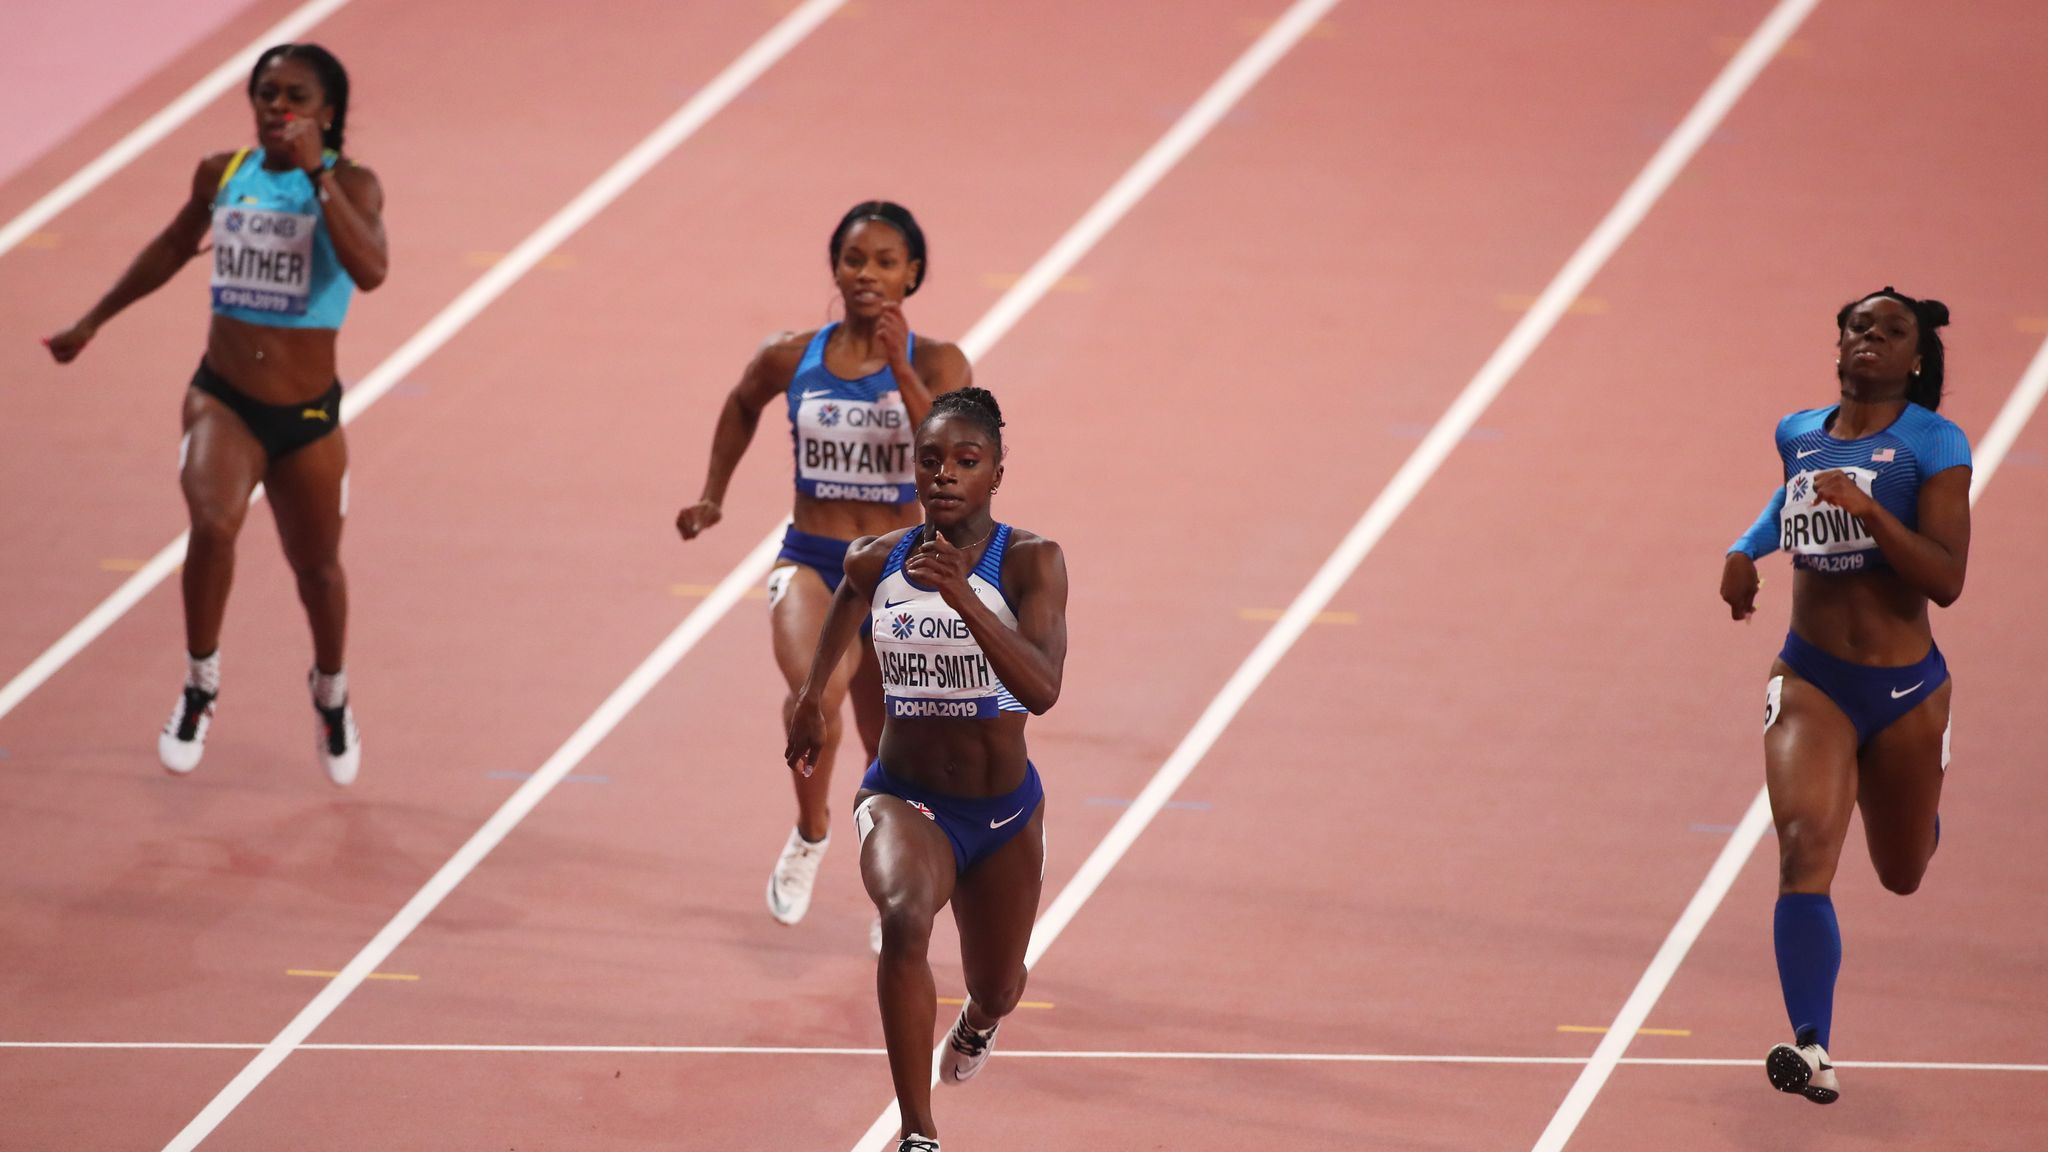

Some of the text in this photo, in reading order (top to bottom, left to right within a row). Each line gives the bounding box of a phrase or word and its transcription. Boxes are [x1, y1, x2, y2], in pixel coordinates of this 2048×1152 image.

[846, 407, 902, 429] QNB
[806, 438, 909, 475] BRYANT
[815, 482, 900, 503] DOHA2019
[919, 617, 970, 640] QNB
[882, 651, 990, 689] ASHER-SMITH
[895, 700, 978, 718] DOHA2019
